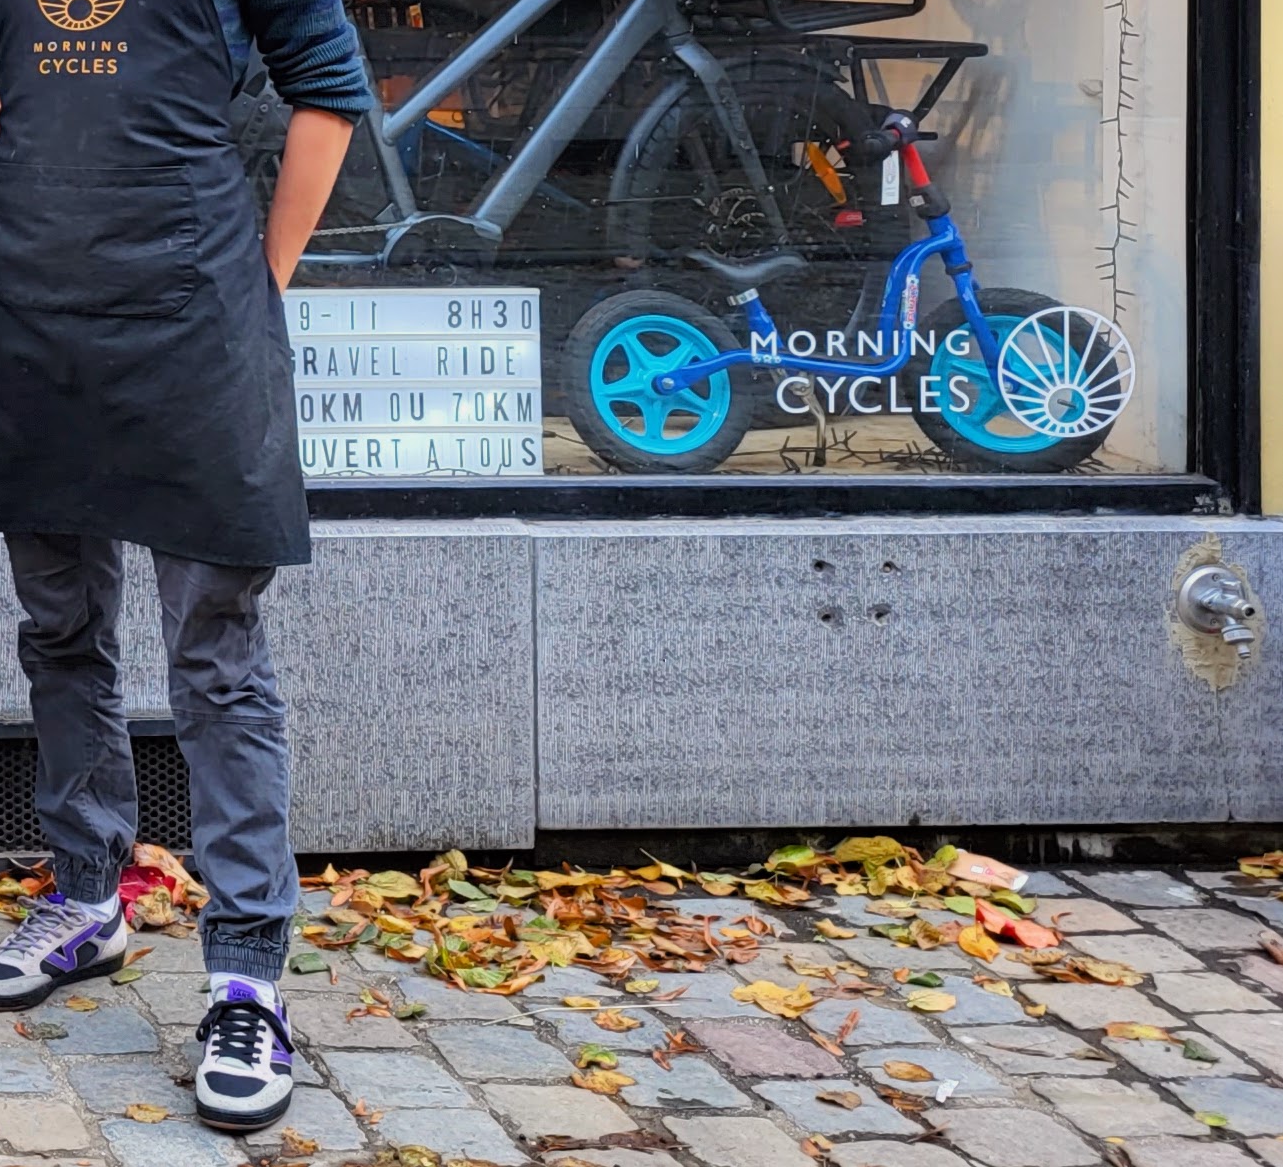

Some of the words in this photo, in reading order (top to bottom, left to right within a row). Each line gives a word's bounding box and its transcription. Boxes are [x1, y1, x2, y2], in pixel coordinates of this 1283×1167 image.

[34, 41, 128, 52] MORNING
[39, 58, 118, 74] CYCLES
[447, 300, 532, 330] 8H30
[750, 330, 971, 356] MORNING
[437, 346, 516, 376] RIDE
[776, 375, 970, 414] CYCLES
[302, 438, 402, 469] UVERT
